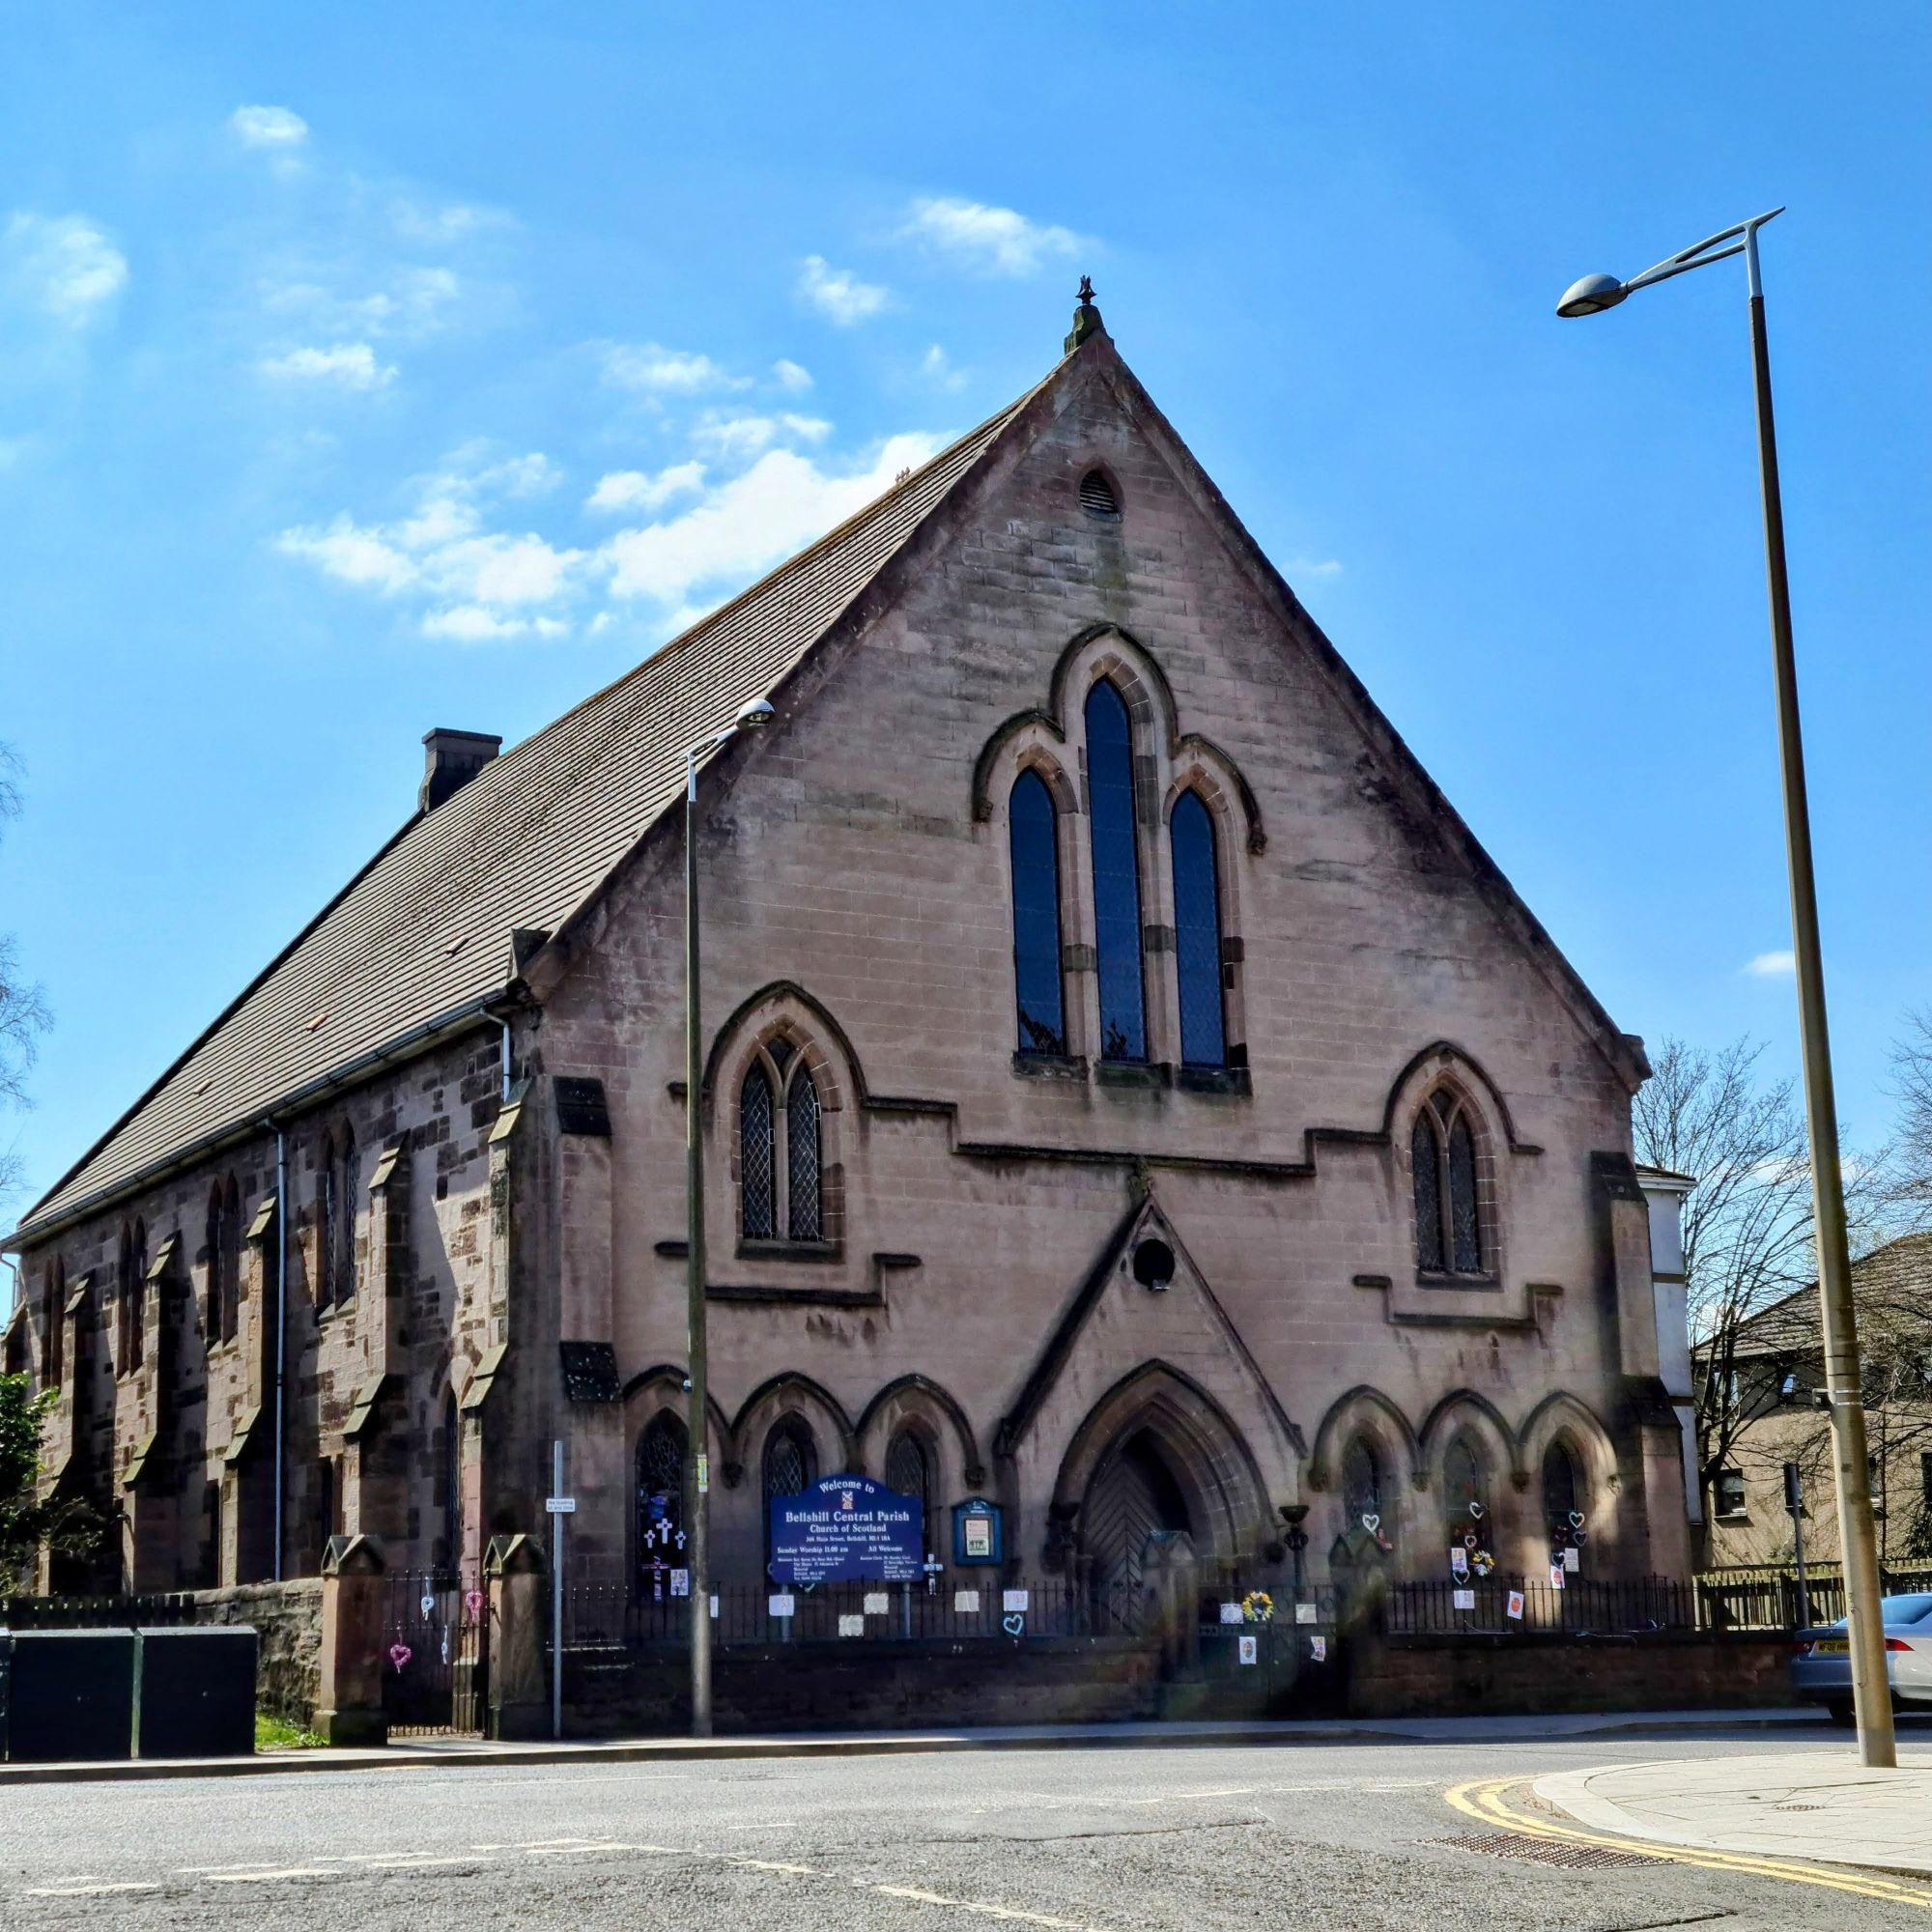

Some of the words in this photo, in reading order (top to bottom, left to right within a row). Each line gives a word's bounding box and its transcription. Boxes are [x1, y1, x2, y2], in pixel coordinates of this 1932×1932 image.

[819, 1479, 862, 1493] Welcome
[865, 1483, 875, 1493] to
[785, 1511, 829, 1522] Bellshill
[833, 1511, 873, 1522] Central
[877, 1510, 910, 1521] Parish
[810, 1523, 838, 1533] Church
[840, 1523, 849, 1533] of
[852, 1523, 887, 1533] Scotland
[777, 1546, 798, 1554] Sunday
[799, 1546, 823, 1554] Worship
